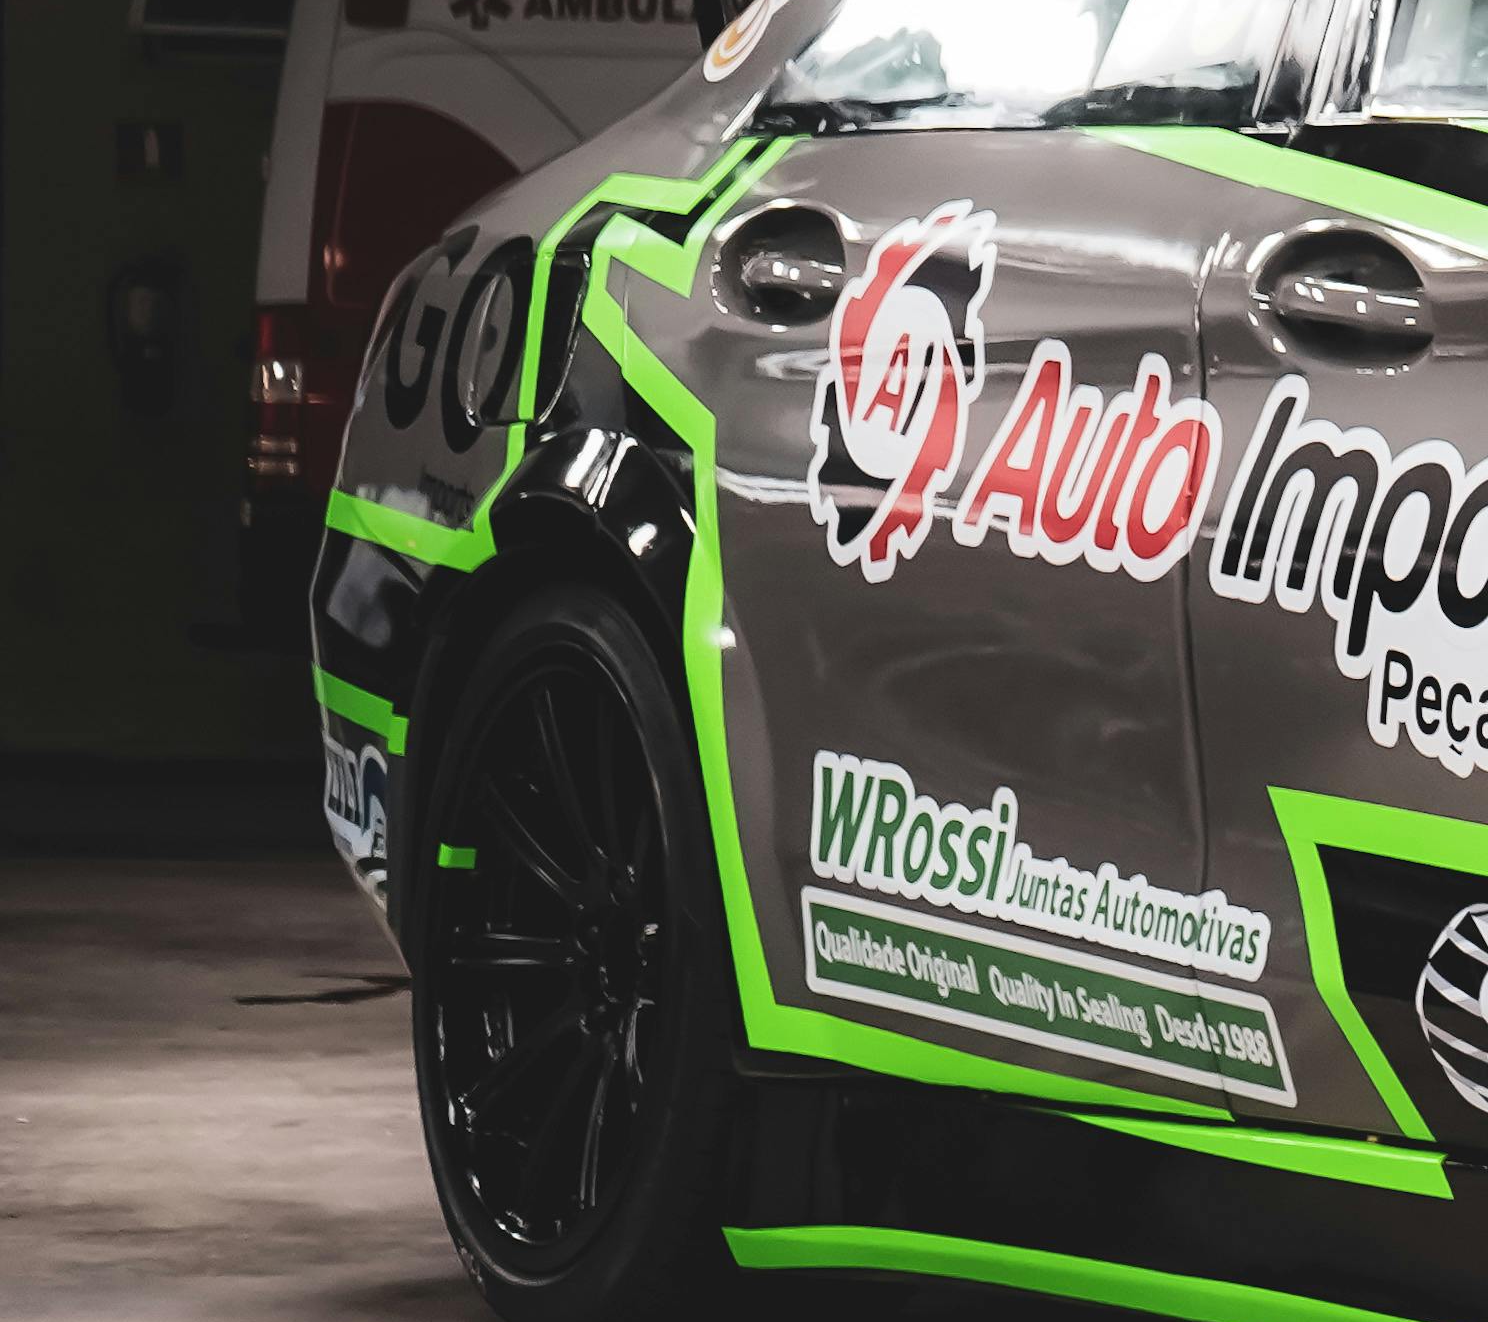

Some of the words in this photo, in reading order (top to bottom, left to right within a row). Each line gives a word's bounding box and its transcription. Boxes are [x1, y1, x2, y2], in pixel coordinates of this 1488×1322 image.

[975, 360, 1209, 561] Auto
[818, 765, 1010, 901] WRossi
[1006, 859, 1088, 922] Juntas
[1092, 878, 1261, 965] Automotivas
[815, 920, 907, 977] Qualidade
[906, 941, 981, 998] Original
[988, 965, 1055, 1022] Quality
[1075, 985, 1153, 1048] Sealing
[1217, 1021, 1274, 1067] 1988
